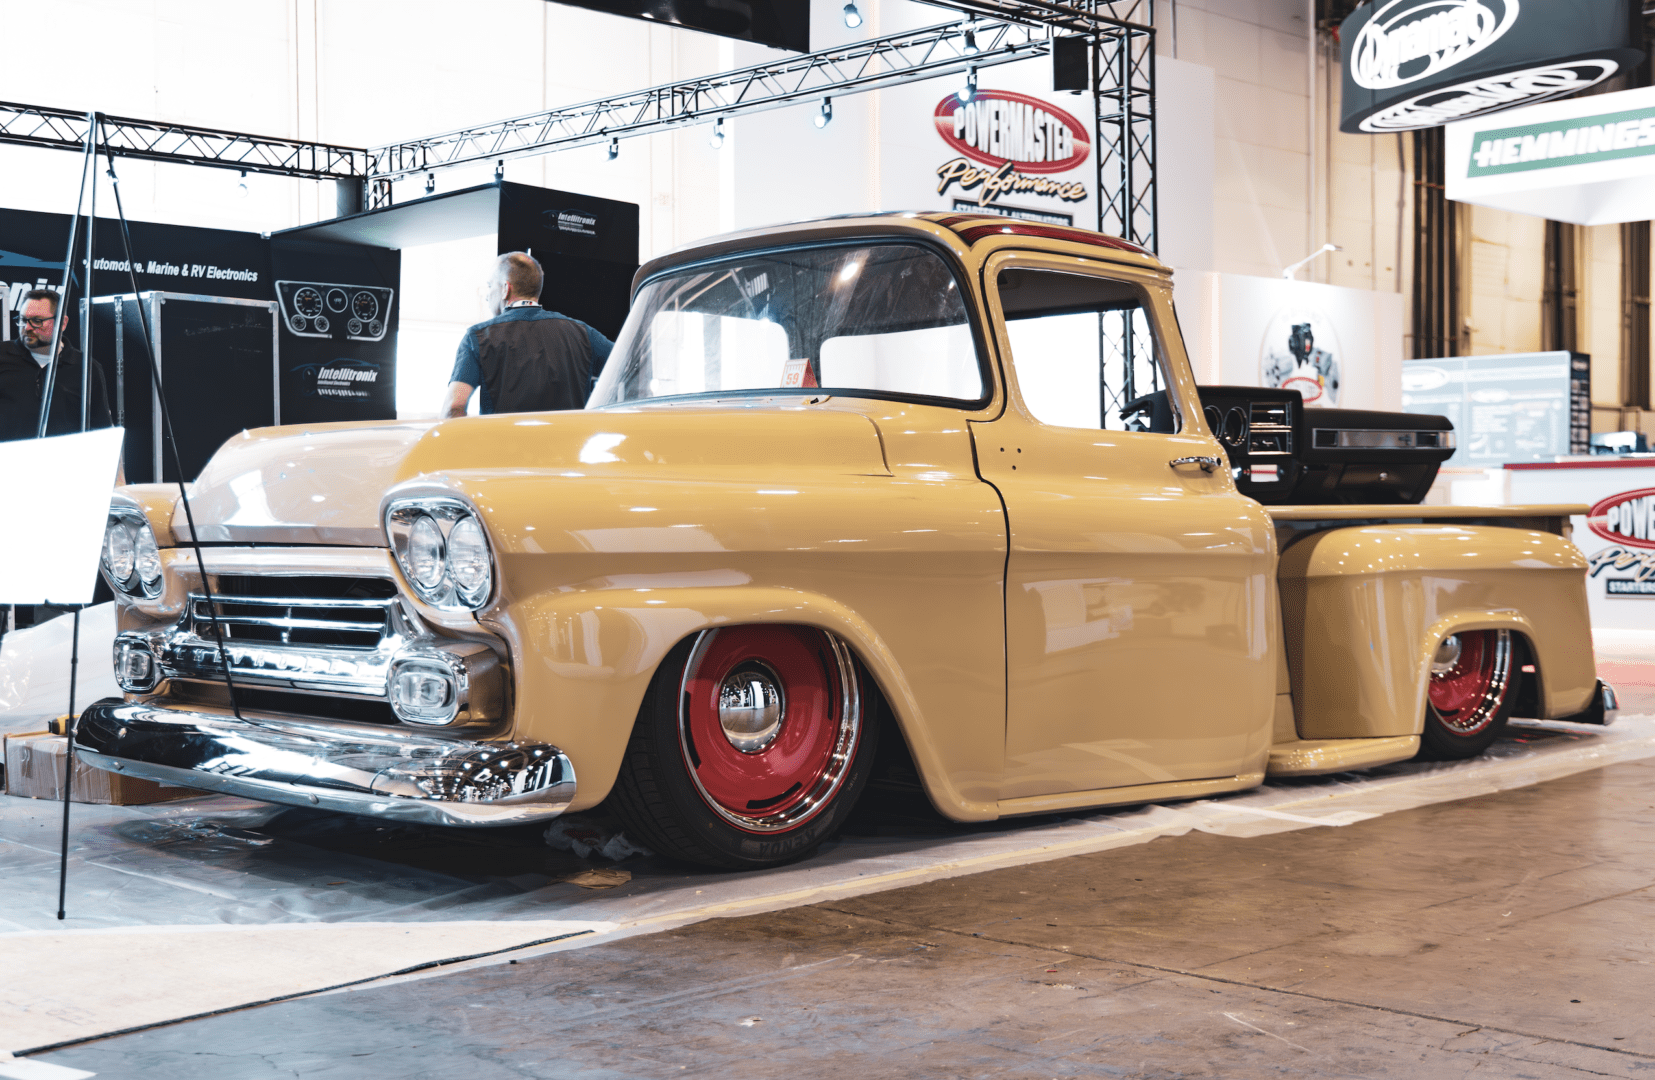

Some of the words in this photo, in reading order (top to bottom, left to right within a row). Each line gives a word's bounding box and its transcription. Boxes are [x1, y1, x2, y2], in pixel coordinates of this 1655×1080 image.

[953, 99, 1074, 163] POWERMASTER
[1473, 117, 1655, 168] HEMMINGS
[936, 157, 1088, 207] Performance
[147, 260, 180, 276] Marine
[181, 263, 189, 276] &
[190, 264, 206, 278] RV
[206, 265, 258, 282] Electronics
[317, 366, 378, 382] Intellitronix
[785, 372, 800, 386] 59
